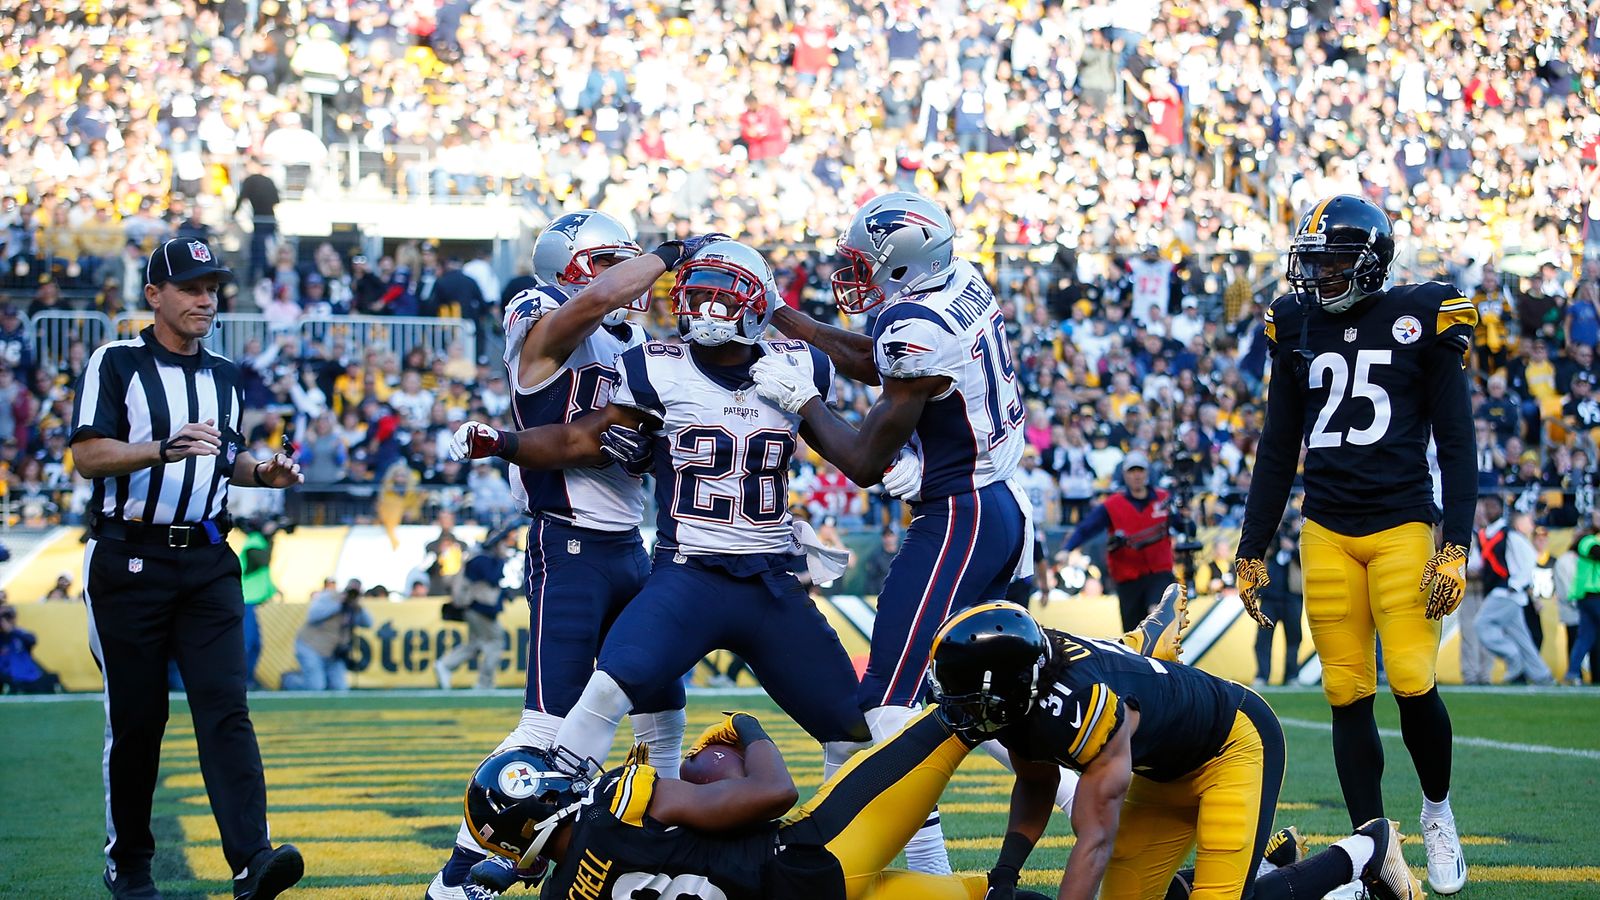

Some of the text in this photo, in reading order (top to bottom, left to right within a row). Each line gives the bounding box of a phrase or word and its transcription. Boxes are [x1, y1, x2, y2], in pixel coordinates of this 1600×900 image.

[1301, 214, 1329, 234] 25
[723, 406, 759, 418] PATRIOTS
[1307, 349, 1393, 449] 25
[671, 424, 797, 526] 28
[1038, 681, 1073, 717] 31
[1263, 829, 1289, 858] NIKE
